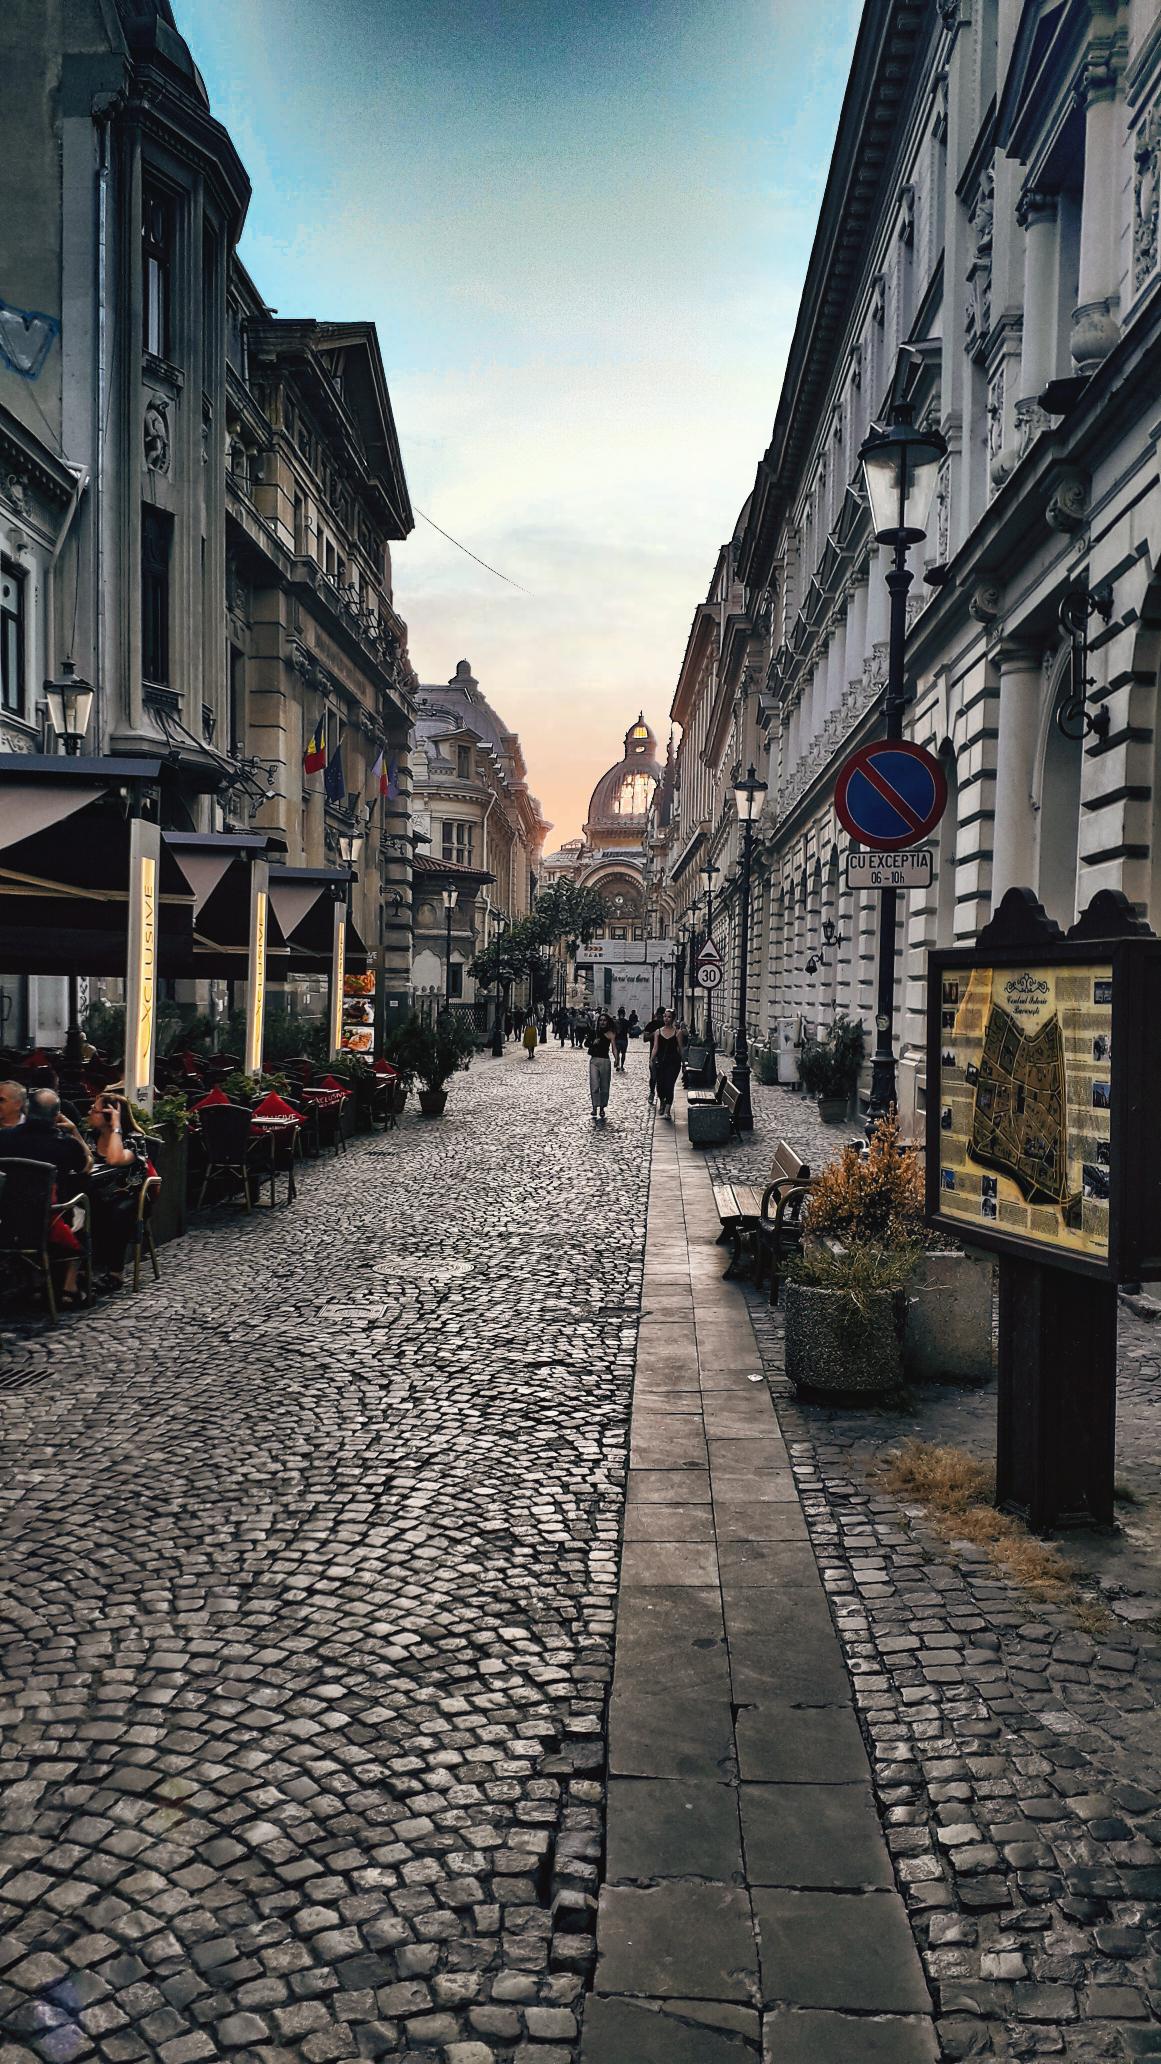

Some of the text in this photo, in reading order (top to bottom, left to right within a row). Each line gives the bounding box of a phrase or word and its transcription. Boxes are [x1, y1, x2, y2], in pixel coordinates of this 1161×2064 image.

[850, 853, 929, 870] CU EXCEPȚIA
[141, 885, 154, 1058] XCLUSIVE
[702, 969, 716, 982] 30
